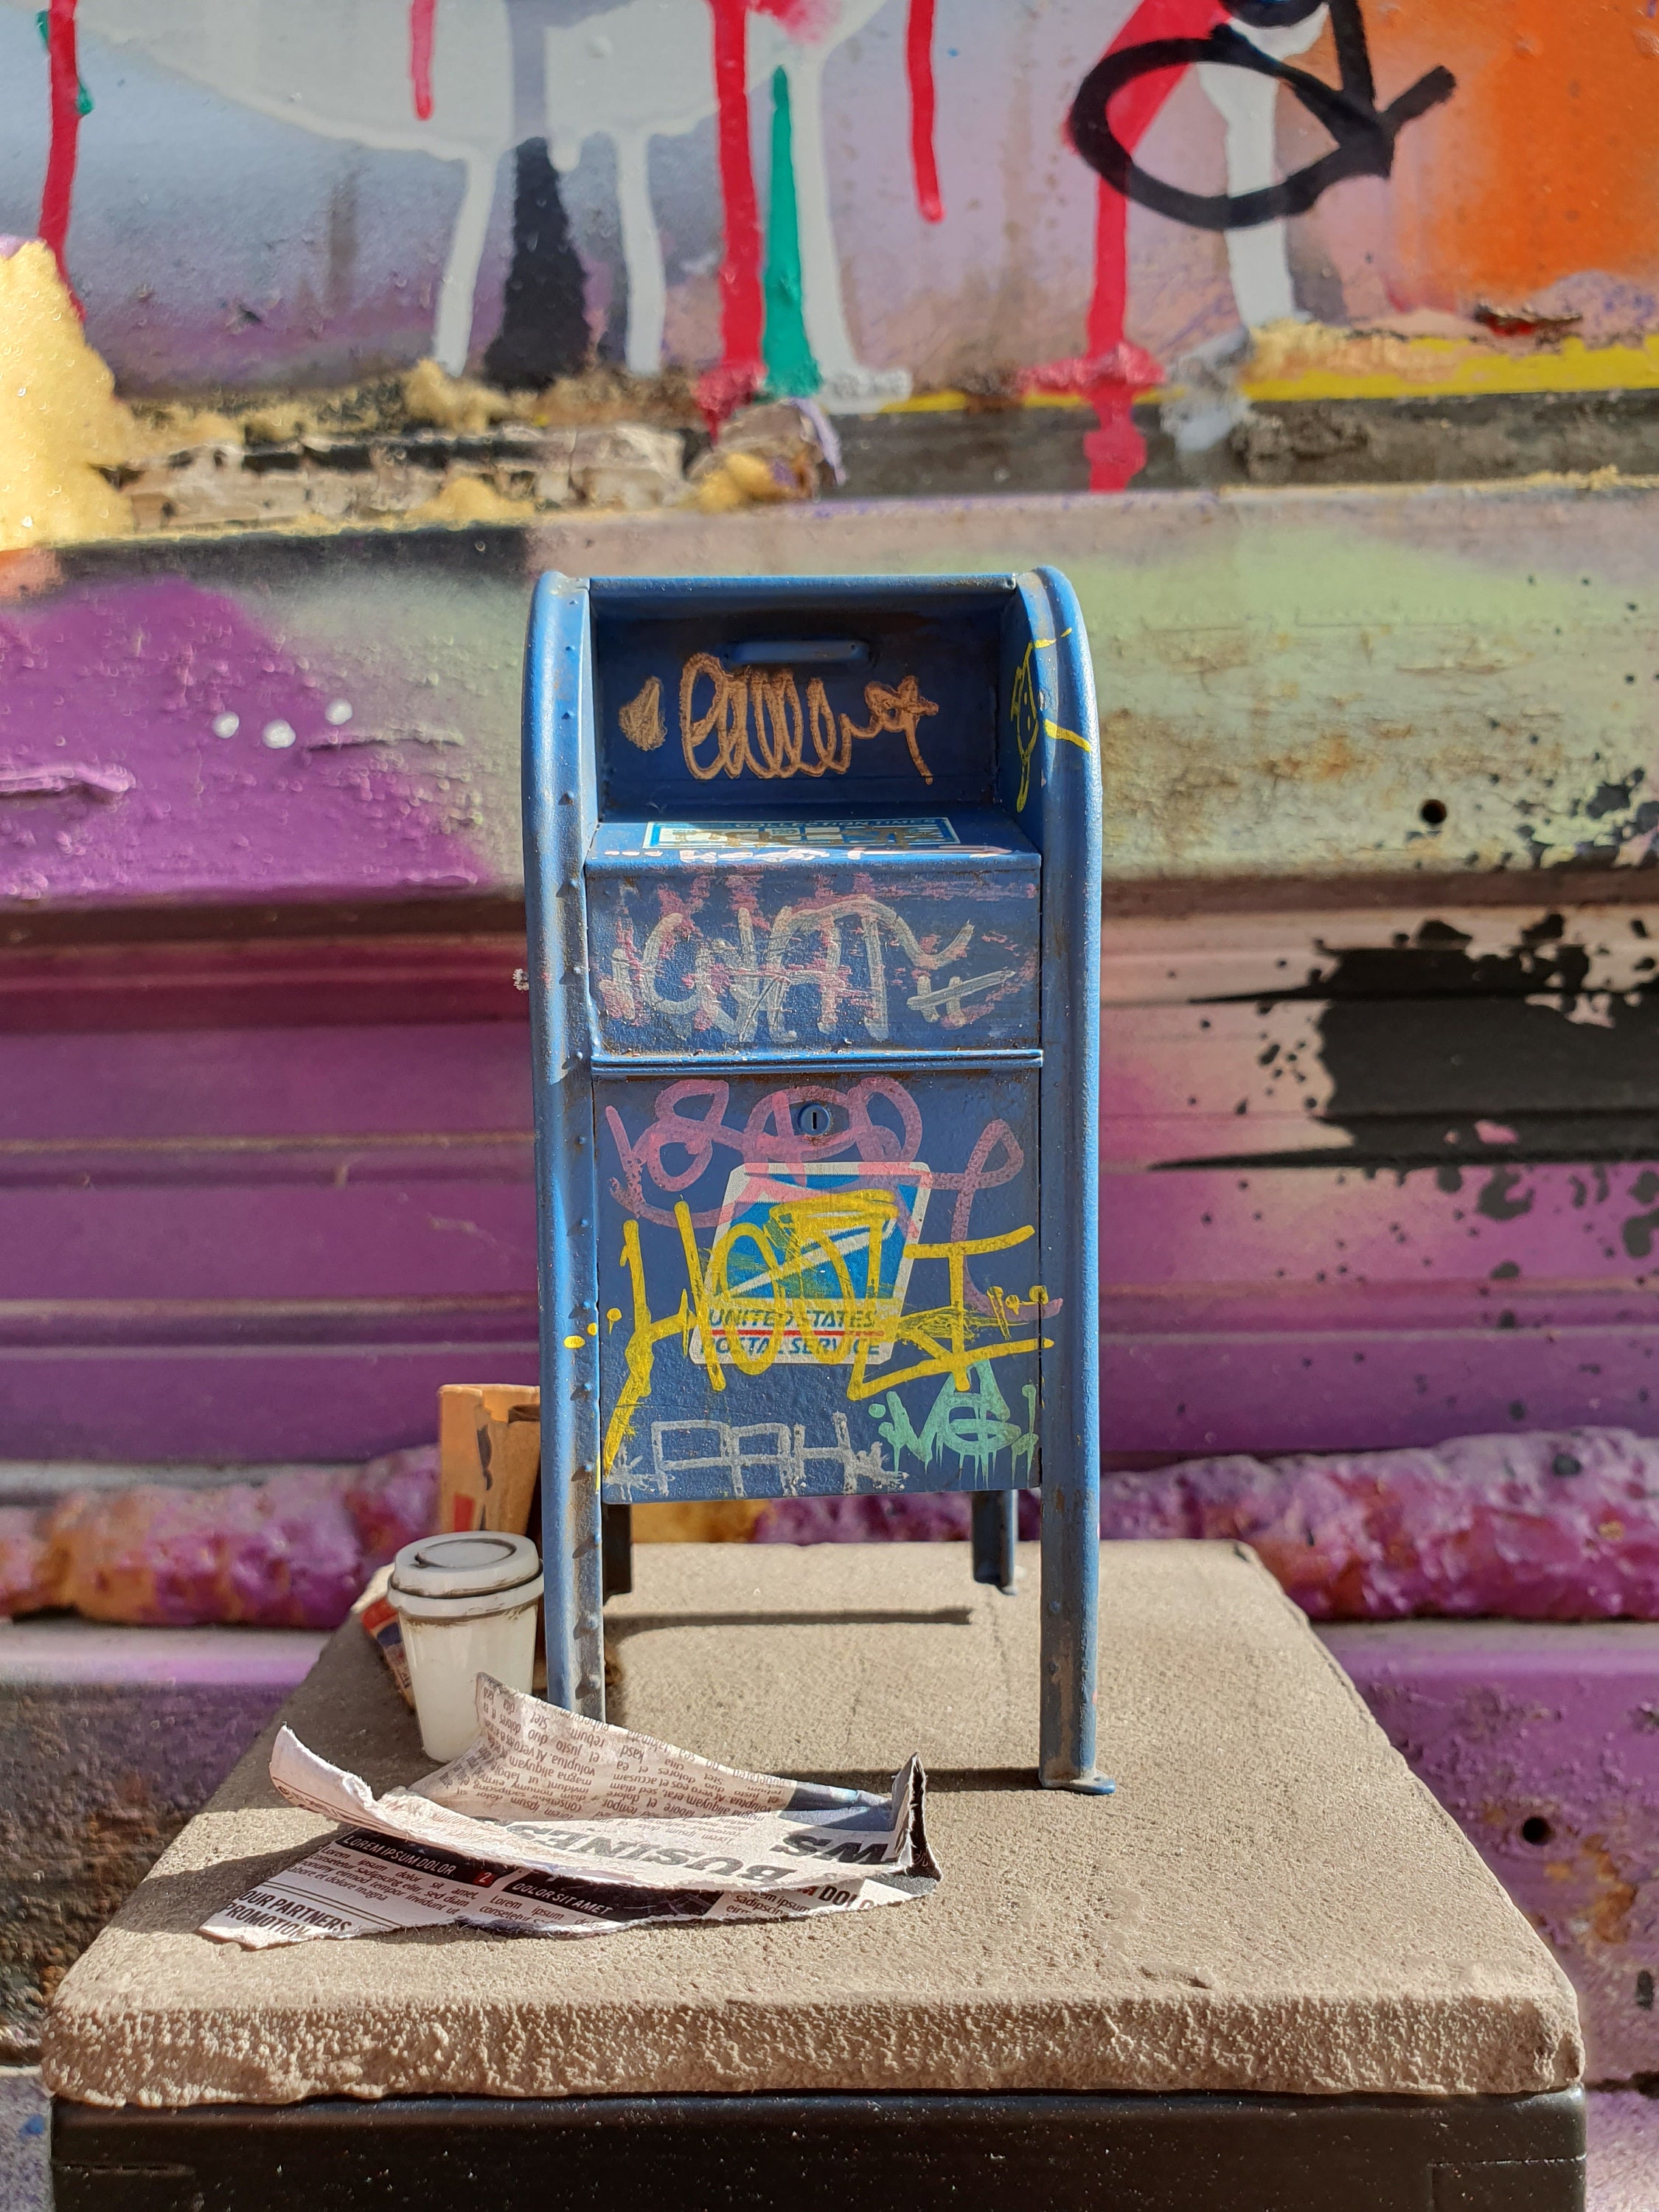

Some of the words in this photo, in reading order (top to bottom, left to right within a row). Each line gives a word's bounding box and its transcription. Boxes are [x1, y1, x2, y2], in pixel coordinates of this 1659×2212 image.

[802, 1309, 877, 1328] TATES
[498, 1713, 521, 1735] dolores
[529, 1711, 550, 1731] Stet
[527, 1729, 549, 1747] duo
[513, 1739, 535, 1758] vero
[535, 1748, 548, 1763] At
[555, 1739, 583, 1757] justo
[619, 1745, 644, 1764] kasd
[549, 1753, 596, 1776] voluptua.
[588, 1750, 600, 1764] et
[664, 1759, 684, 1770] clita
[508, 1755, 554, 1778] aliquyam
[616, 1760, 630, 1771] ea
[527, 1775, 539, 1784] ut
[557, 1771, 592, 1786] magna
[613, 1773, 658, 1785] accusam
[658, 1767, 696, 1784] dolores
[658, 1778, 669, 1787] et
[703, 1772, 723, 1785] Stet
[456, 1787, 468, 1795] sit
[472, 1778, 526, 1798] sadipscing
[510, 1780, 554, 1797] nonumy
[546, 1780, 589, 1794] invidunt
[610, 1782, 636, 1793] diam
[638, 1787, 658, 1795] sed
[672, 1781, 689, 1791] eos
[691, 1787, 713, 1798] vero
[704, 1783, 725, 1793] duo
[476, 1792, 504, 1801] dolor
[560, 1793, 586, 1802] diam
[606, 1790, 640, 1805] dolore
[646, 1797, 658, 1808] et
[662, 1789, 684, 1801] erat,
[715, 1792, 726, 1802] At
[734, 1790, 759, 1801] justo
[510, 1797, 540, 1813] ipsum
[601, 1799, 638, 1815] tempor
[664, 1803, 695, 1818] labore
[686, 1795, 731, 1815] aliquyam
[729, 1796, 772, 1813] voluptua.
[665, 1829, 696, 1838] ipsum
[343, 1835, 385, 1854] LOREM
[383, 1847, 420, 1865] IPSUM
[417, 1857, 457, 1875] DOLOR
[479, 1871, 491, 1883] 2
[310, 1853, 357, 1870] consetetur
[358, 1865, 403, 1888] sadipscing
[403, 1881, 422, 1894] elitr,
[424, 1888, 444, 1900] sed
[443, 1893, 470, 1908] diam
[321, 1846, 351, 1859] Lorem
[358, 1858, 388, 1872] ipsum
[395, 1870, 423, 1882] dolor
[429, 1880, 443, 1890] sit
[451, 1887, 479, 1900] amet,
[315, 1872, 326, 1880] et
[325, 1874, 357, 1891] dolore
[357, 1887, 389, 1902] magna
[335, 1870, 369, 1884] eirmod
[370, 1879, 407, 1897] tempor
[406, 1893, 447, 1911] invidunt
[447, 1906, 461, 1916] ut
[512, 1882, 554, 1900] DOLOR
[552, 1893, 576, 1905] SIT
[571, 1900, 614, 1916] AMET
[776, 1896, 811, 1913] ipsum
[238, 1890, 276, 1909] OUR
[267, 1899, 352, 1932] PARTNERS
[490, 1895, 523, 1910] Lorem
[531, 1905, 565, 1920] ipsum
